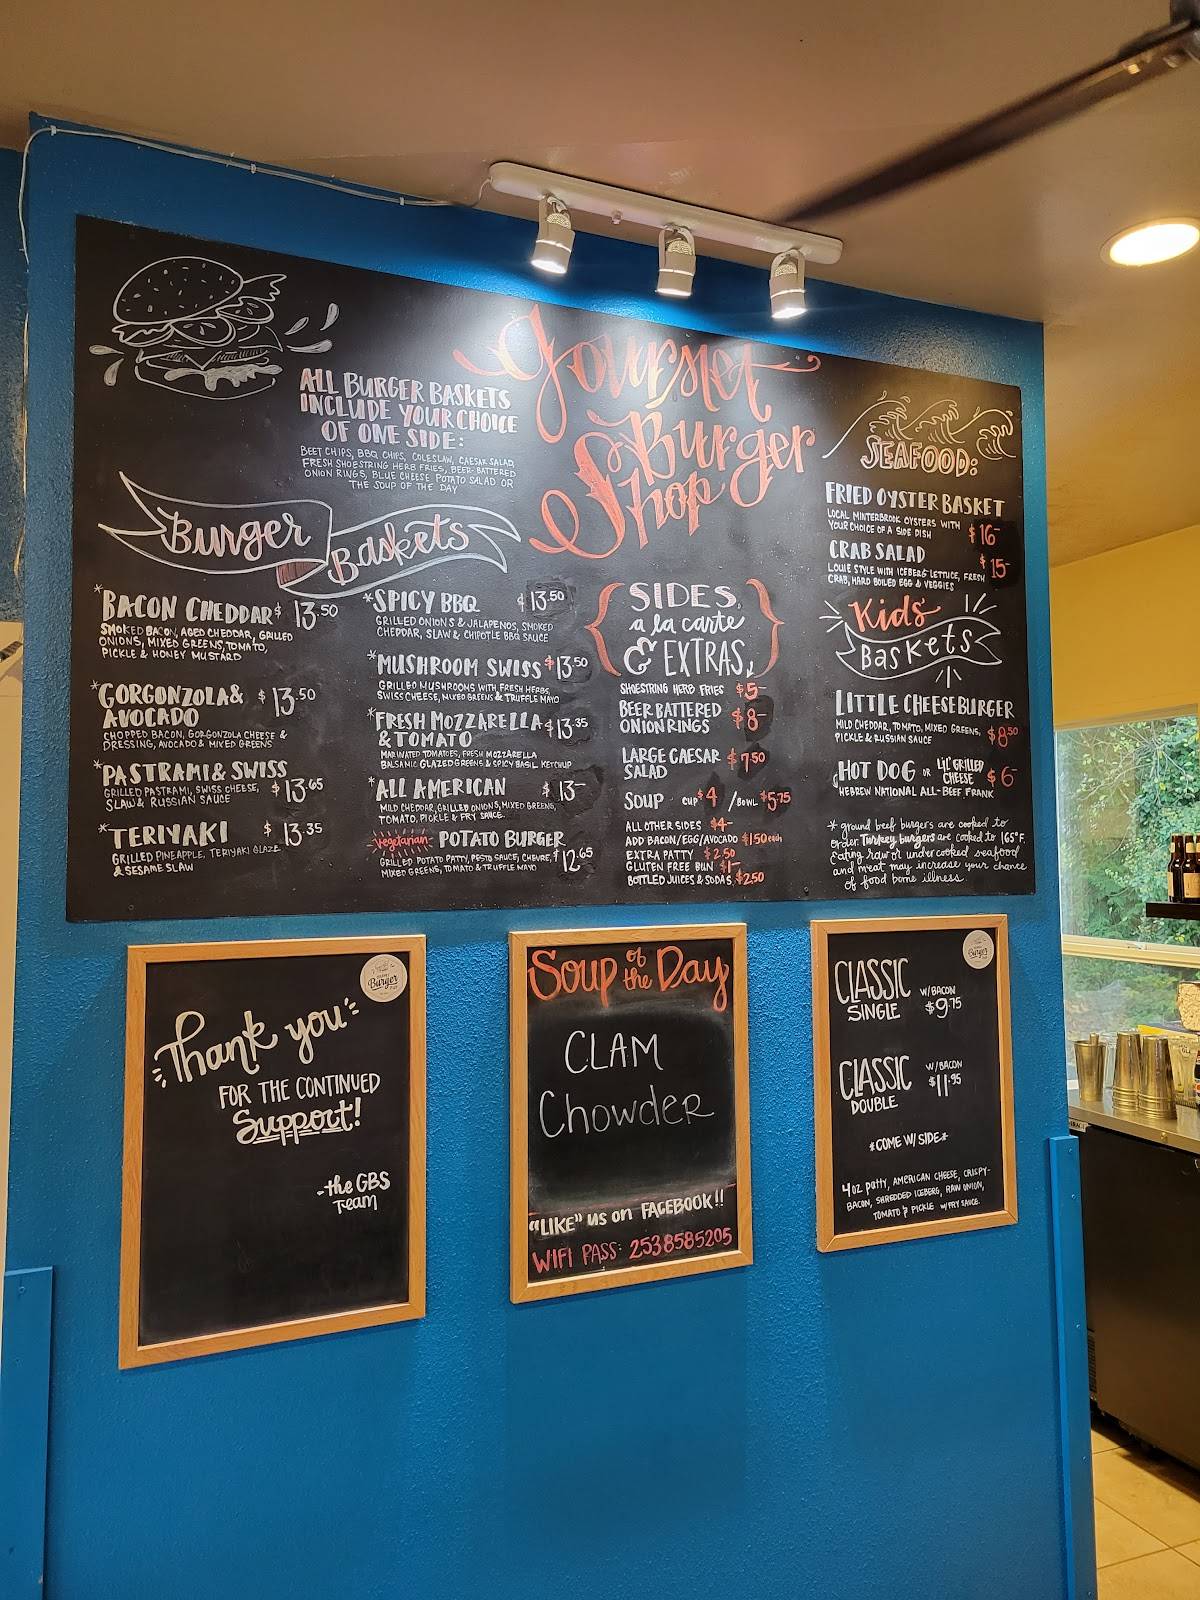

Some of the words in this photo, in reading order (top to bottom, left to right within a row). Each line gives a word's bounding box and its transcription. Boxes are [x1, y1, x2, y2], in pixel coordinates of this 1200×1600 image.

[300, 368, 340, 394] ALL
[344, 372, 424, 403] BURGER
[429, 382, 511, 410] BASKETS
[300, 393, 391, 421] INCLUDE
[399, 403, 452, 429] YOUR
[457, 409, 520, 433] CHOICE
[321, 420, 350, 442] OF
[359, 424, 400, 445] ONE
[406, 430, 464, 451] SIDE:
[301, 446, 322, 457] BEET
[459, 457, 488, 467] CAESAR
[336, 460, 389, 471] SHOESTRING
[393, 463, 416, 472] HERB
[586, 411, 816, 508] Burger
[860, 435, 979, 478] SEAFOOD:
[373, 471, 396, 481] BLUE
[400, 472, 430, 482] CHEESE
[436, 474, 466, 485] POTATO
[373, 481, 397, 491] SOUP
[440, 484, 459, 495] DAY
[529, 432, 726, 559] Shop
[826, 482, 872, 504] FRIED
[877, 488, 938, 511] OYSTER
[942, 494, 1006, 518] BASKET
[157, 506, 311, 561] Burger
[328, 512, 470, 586] Baskets
[830, 540, 871, 560] CRAB
[875, 542, 925, 563] SALAD
[186, 596, 273, 625] CHEDDAR
[441, 593, 480, 613] BBQ
[100, 623, 144, 637] SMOKED
[181, 627, 206, 637] AGED
[259, 631, 293, 642] GRILLED
[629, 618, 646, 633] a
[650, 614, 676, 636] la
[682, 612, 745, 634] carte
[148, 638, 179, 648] MIXED
[522, 632, 548, 643] SAUCE
[862, 623, 973, 670] Baskets
[102, 648, 138, 660] PICKLE
[153, 650, 186, 661] HONEY
[191, 652, 242, 662] MUSTARD
[664, 638, 746, 677] EXTRAS
[487, 658, 542, 680] SWISS
[620, 683, 668, 696] SHOESTRING
[673, 684, 695, 695] HERB
[700, 684, 724, 696] FRIES
[619, 700, 653, 719] BEER
[656, 702, 722, 717] BATTERED
[836, 690, 899, 717] LITTLE
[904, 694, 1016, 720] CHEESEBURGER
[103, 707, 201, 728] AVOCADO
[430, 710, 543, 733] MOZZARELLA
[620, 719, 664, 734] ONION
[667, 718, 710, 734] RINGS
[378, 730, 393, 749] &
[393, 731, 472, 749] TOMATO
[622, 747, 667, 764] LARGE
[669, 748, 721, 765] CAESAR
[230, 760, 288, 780] SWISS
[624, 764, 668, 780] SALAD
[838, 760, 871, 782] HOT
[877, 760, 915, 783] DOG
[953, 758, 984, 775] GRILLED
[943, 772, 973, 786] CHEESE
[413, 777, 506, 801] AMERICAN
[839, 786, 871, 797] HEBREW
[875, 786, 918, 797] NATIONAL
[965, 788, 995, 799] FRANK
[624, 792, 665, 811] SOUP
[682, 797, 698, 807] CUP
[625, 821, 643, 832] ALL
[645, 821, 674, 832] OTHER
[676, 821, 702, 831] SIDES
[439, 830, 500, 850] POTATO
[504, 829, 566, 850] BURGER
[625, 836, 645, 848] ADD
[626, 850, 661, 861] EXTRA
[663, 849, 694, 861] PATTY
[626, 861, 664, 872] GLUTEN
[668, 862, 690, 872] FREE
[695, 861, 713, 872] BUN
[627, 874, 665, 887] BOTTLED
[667, 874, 695, 887] JUICES
[626, 947, 648, 969] of
[527, 949, 618, 1009] Soup
[622, 967, 653, 991] the
[657, 945, 731, 1013] Day
[835, 957, 912, 1005] CLASSIC
[847, 1003, 900, 1022] SINGLE
[154, 1010, 279, 1083] Thank
[284, 1004, 348, 1066] you
[564, 1029, 665, 1074] CLAM
[839, 1055, 912, 1100] CLASSIC
[219, 1084, 252, 1110] FOR
[258, 1078, 291, 1104] THE
[296, 1073, 381, 1101] CONTINUED
[851, 1095, 899, 1116] DOUBLE
[233, 1097, 362, 1147] Support!
[356, 1171, 391, 1192] GBS
[333, 1194, 378, 1216] Team
[876, 1191, 912, 1205] SHREDDED
[588, 1214, 608, 1227] us
[612, 1208, 633, 1224] on
[873, 1207, 902, 1221] TOMATO
[911, 1202, 935, 1216] PICKLE
[532, 1248, 573, 1274] WIFI
[629, 1227, 733, 1261] 2538585205
